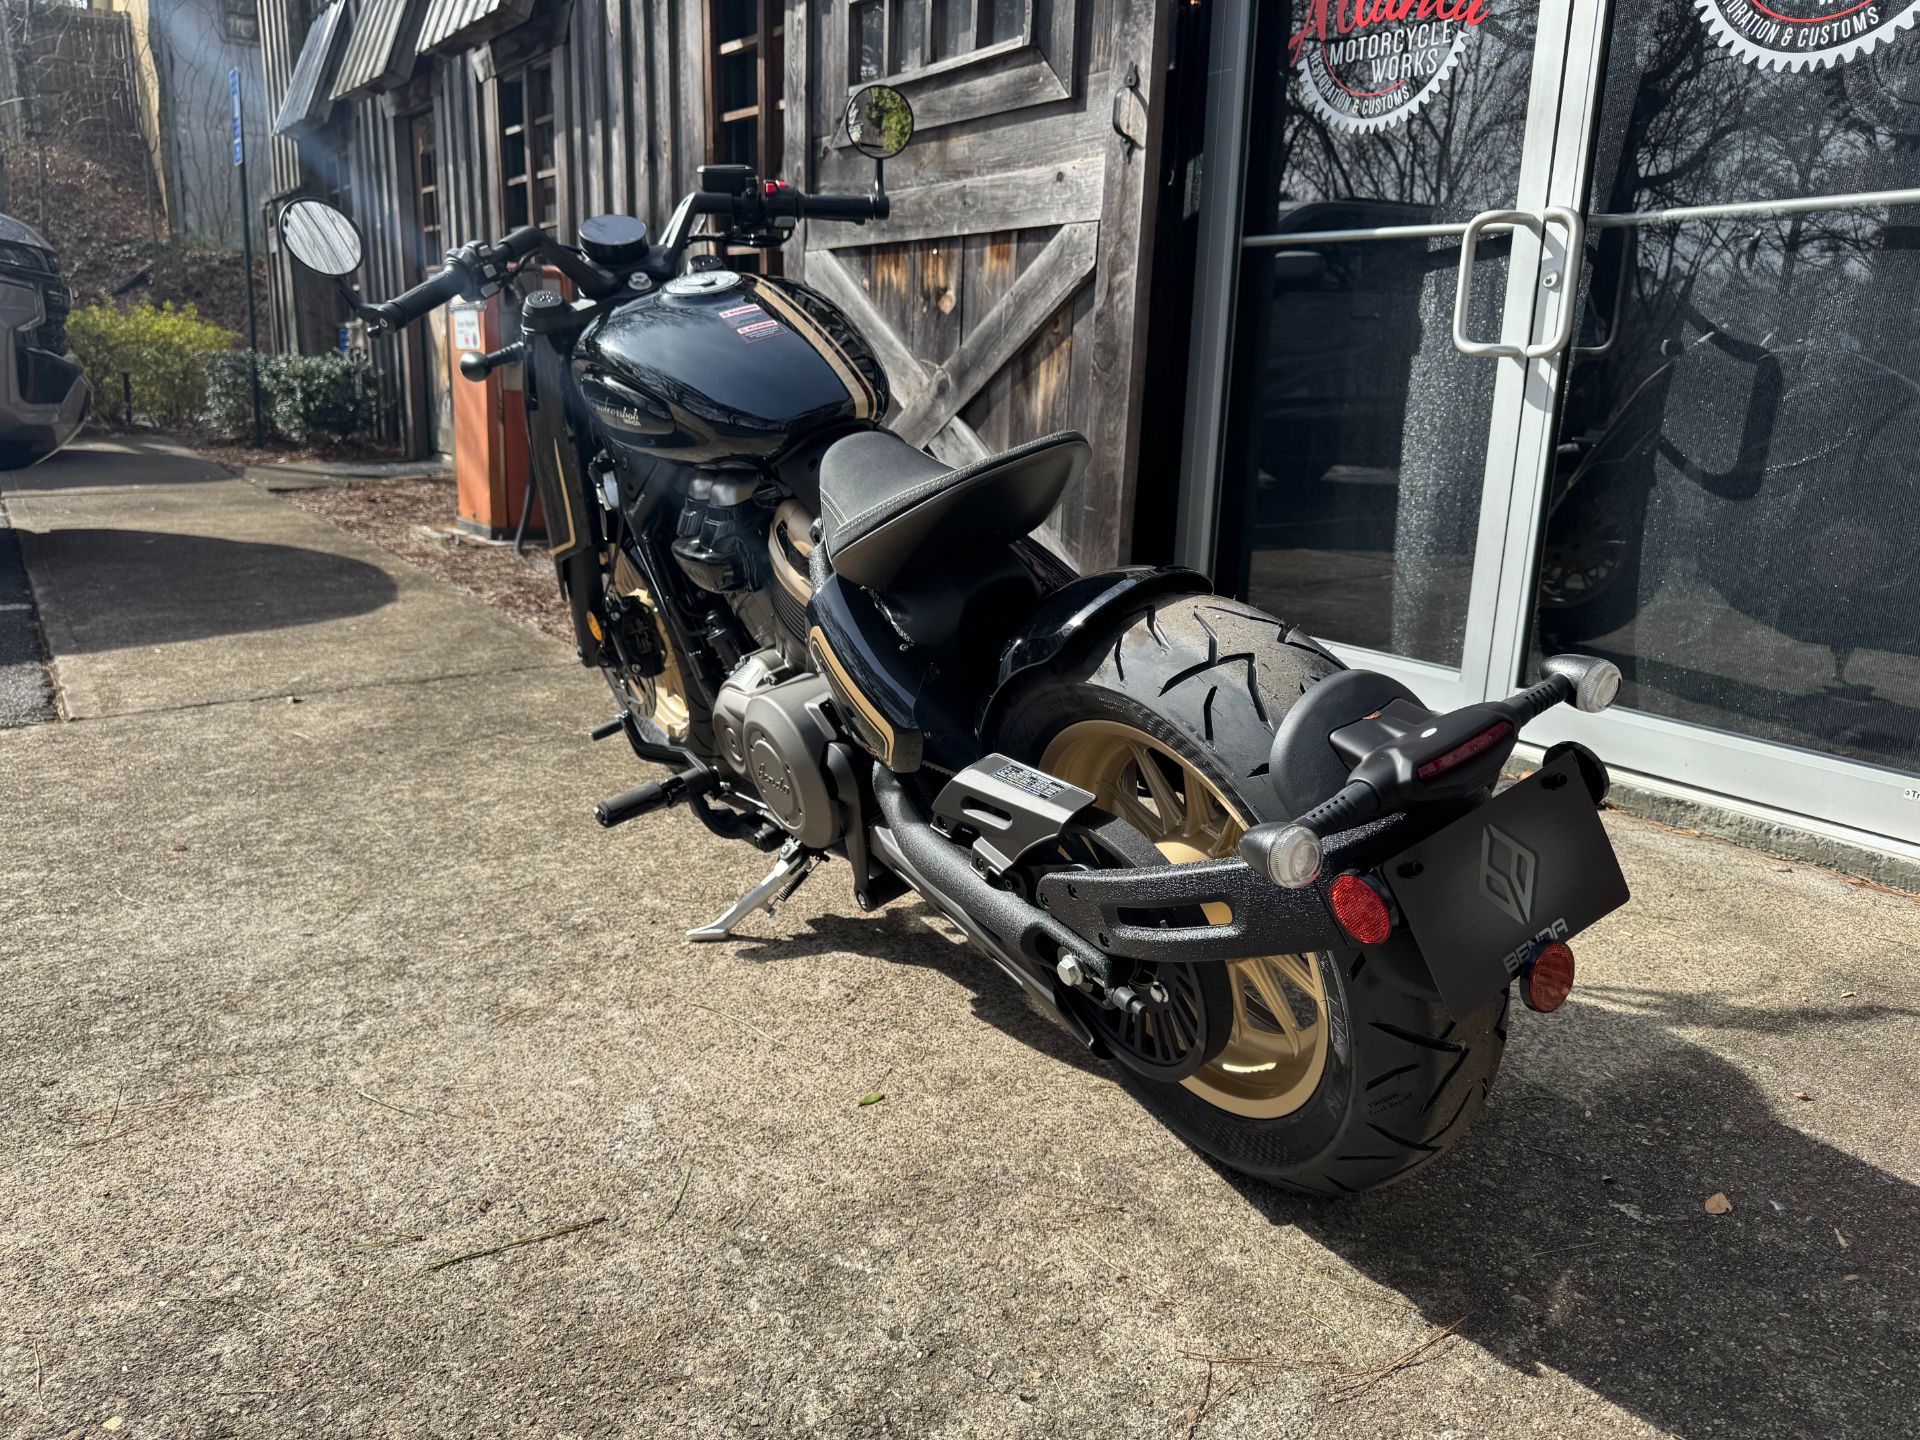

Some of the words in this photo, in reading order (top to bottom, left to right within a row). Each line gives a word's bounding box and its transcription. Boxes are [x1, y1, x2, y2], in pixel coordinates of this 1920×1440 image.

[1329, 19, 1454, 66] MOTORCYCLE
[1780, 28, 1794, 47] &
[1797, 6, 1880, 47] CUSTOMS
[1310, 50, 1352, 112] RESTORATION
[1351, 101, 1362, 114] &
[1361, 86, 1410, 115] CUSTOMS
[1371, 49, 1439, 84] WORKS
